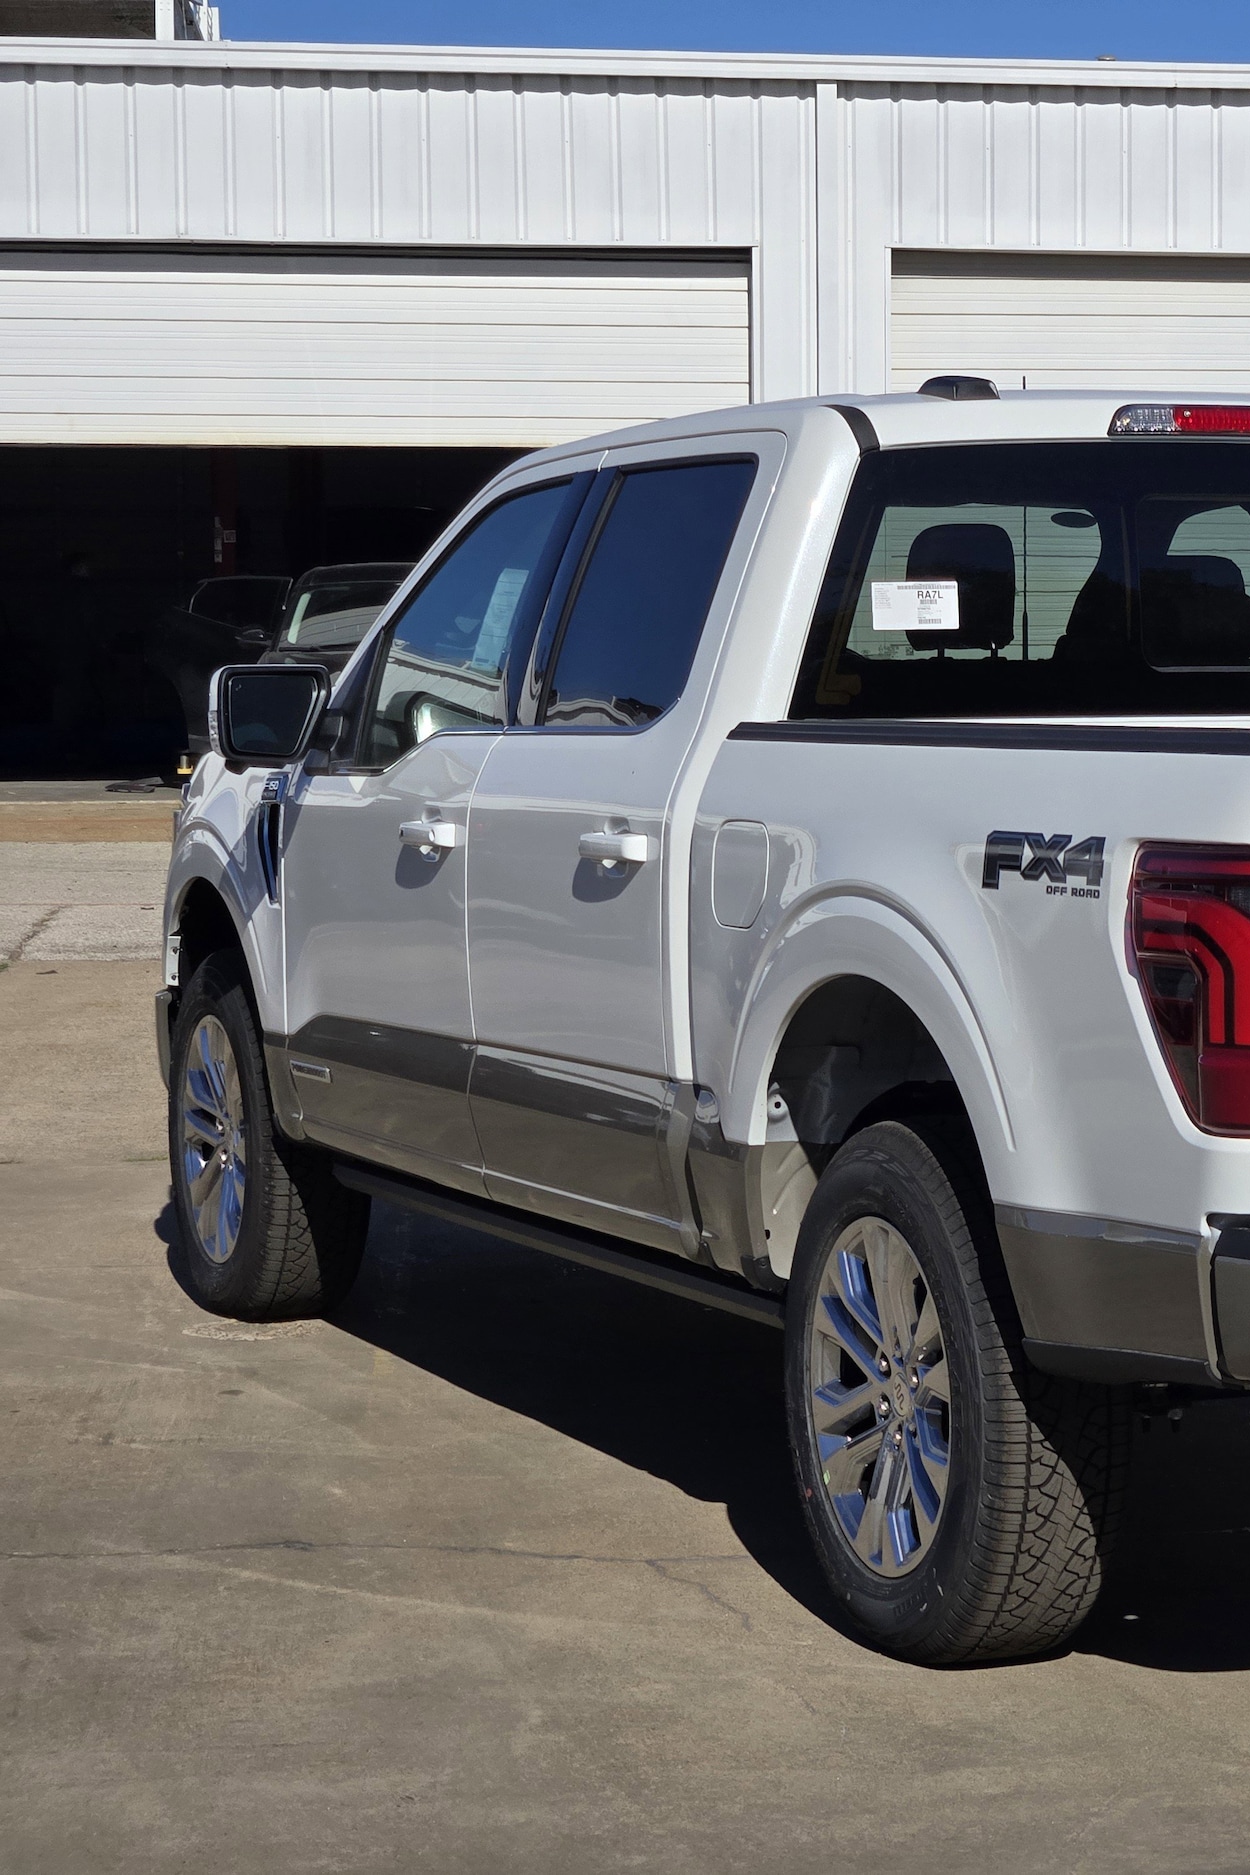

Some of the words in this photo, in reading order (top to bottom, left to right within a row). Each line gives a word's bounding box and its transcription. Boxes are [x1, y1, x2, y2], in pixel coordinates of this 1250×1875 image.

[917, 590, 943, 599] RA7L
[982, 830, 1106, 890] FX4
[1046, 885, 1067, 896] OFF
[1071, 888, 1100, 899] ROAD
